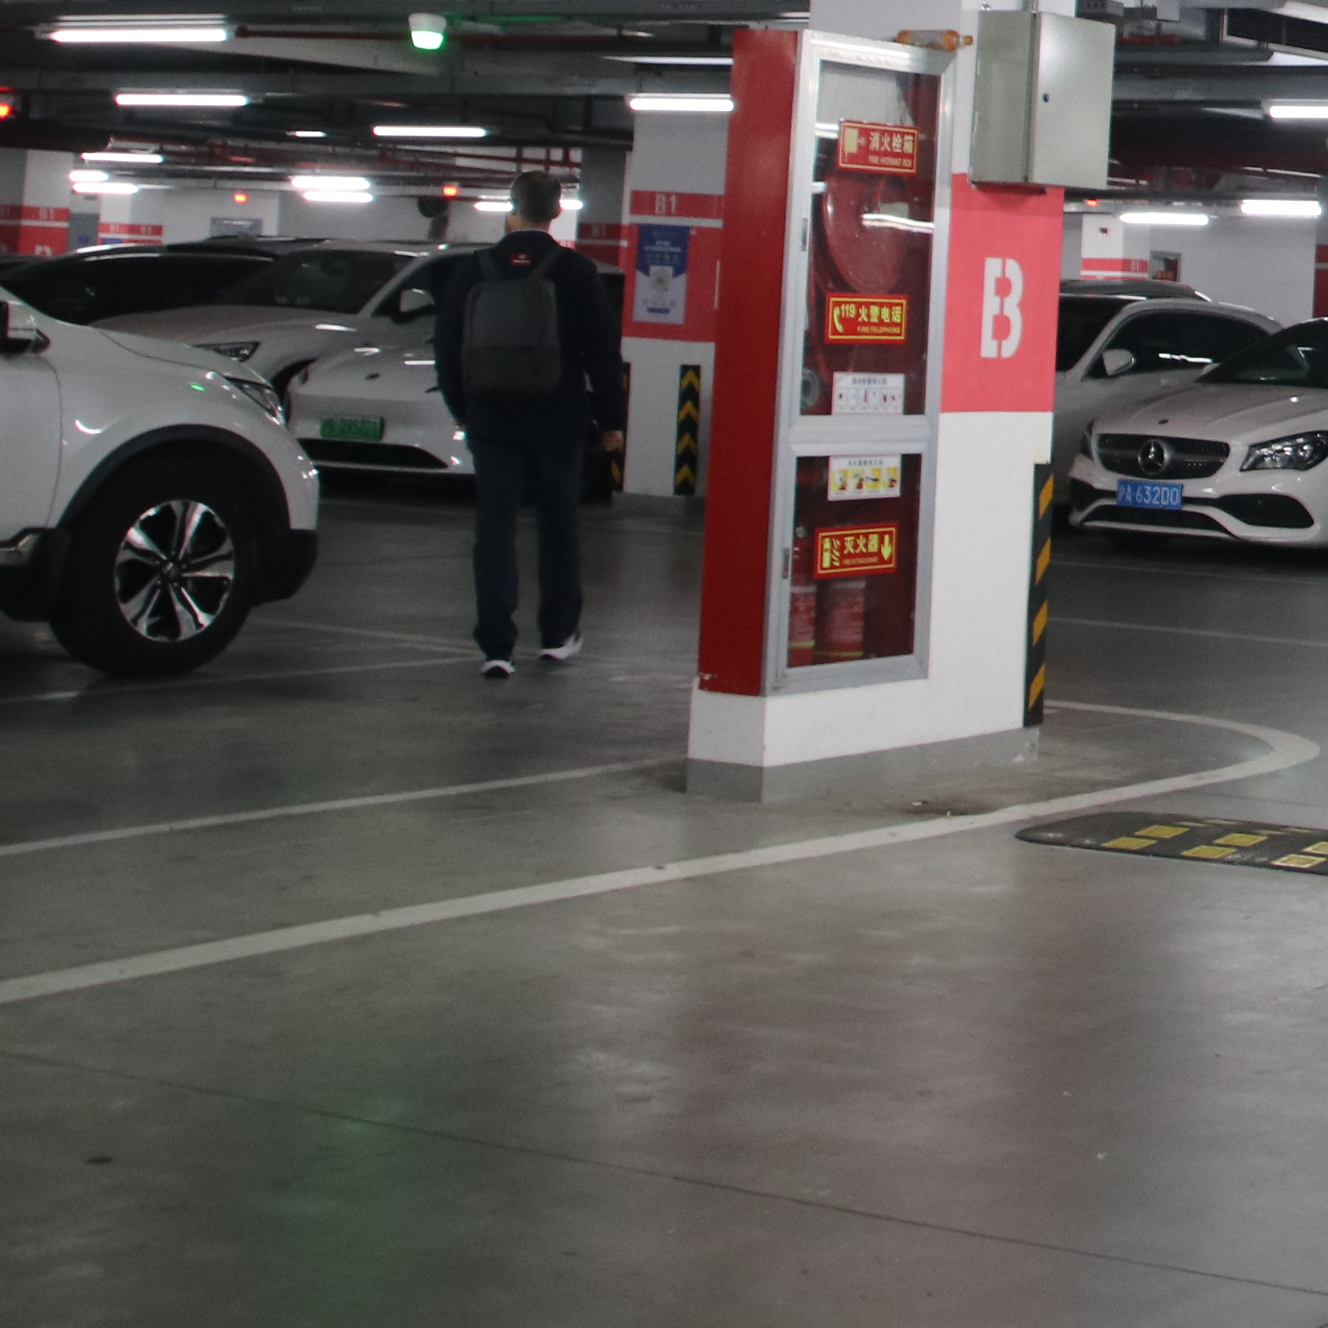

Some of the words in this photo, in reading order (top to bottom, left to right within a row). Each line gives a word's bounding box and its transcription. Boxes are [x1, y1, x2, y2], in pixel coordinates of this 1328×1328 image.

[868, 131, 914, 154] 消火栓箱
[655, 193, 677, 214] B1
[841, 303, 856, 319] 119
[858, 305, 902, 323] 火警电话
[980, 256, 1024, 359] B
[843, 533, 879, 554] 灭火器
